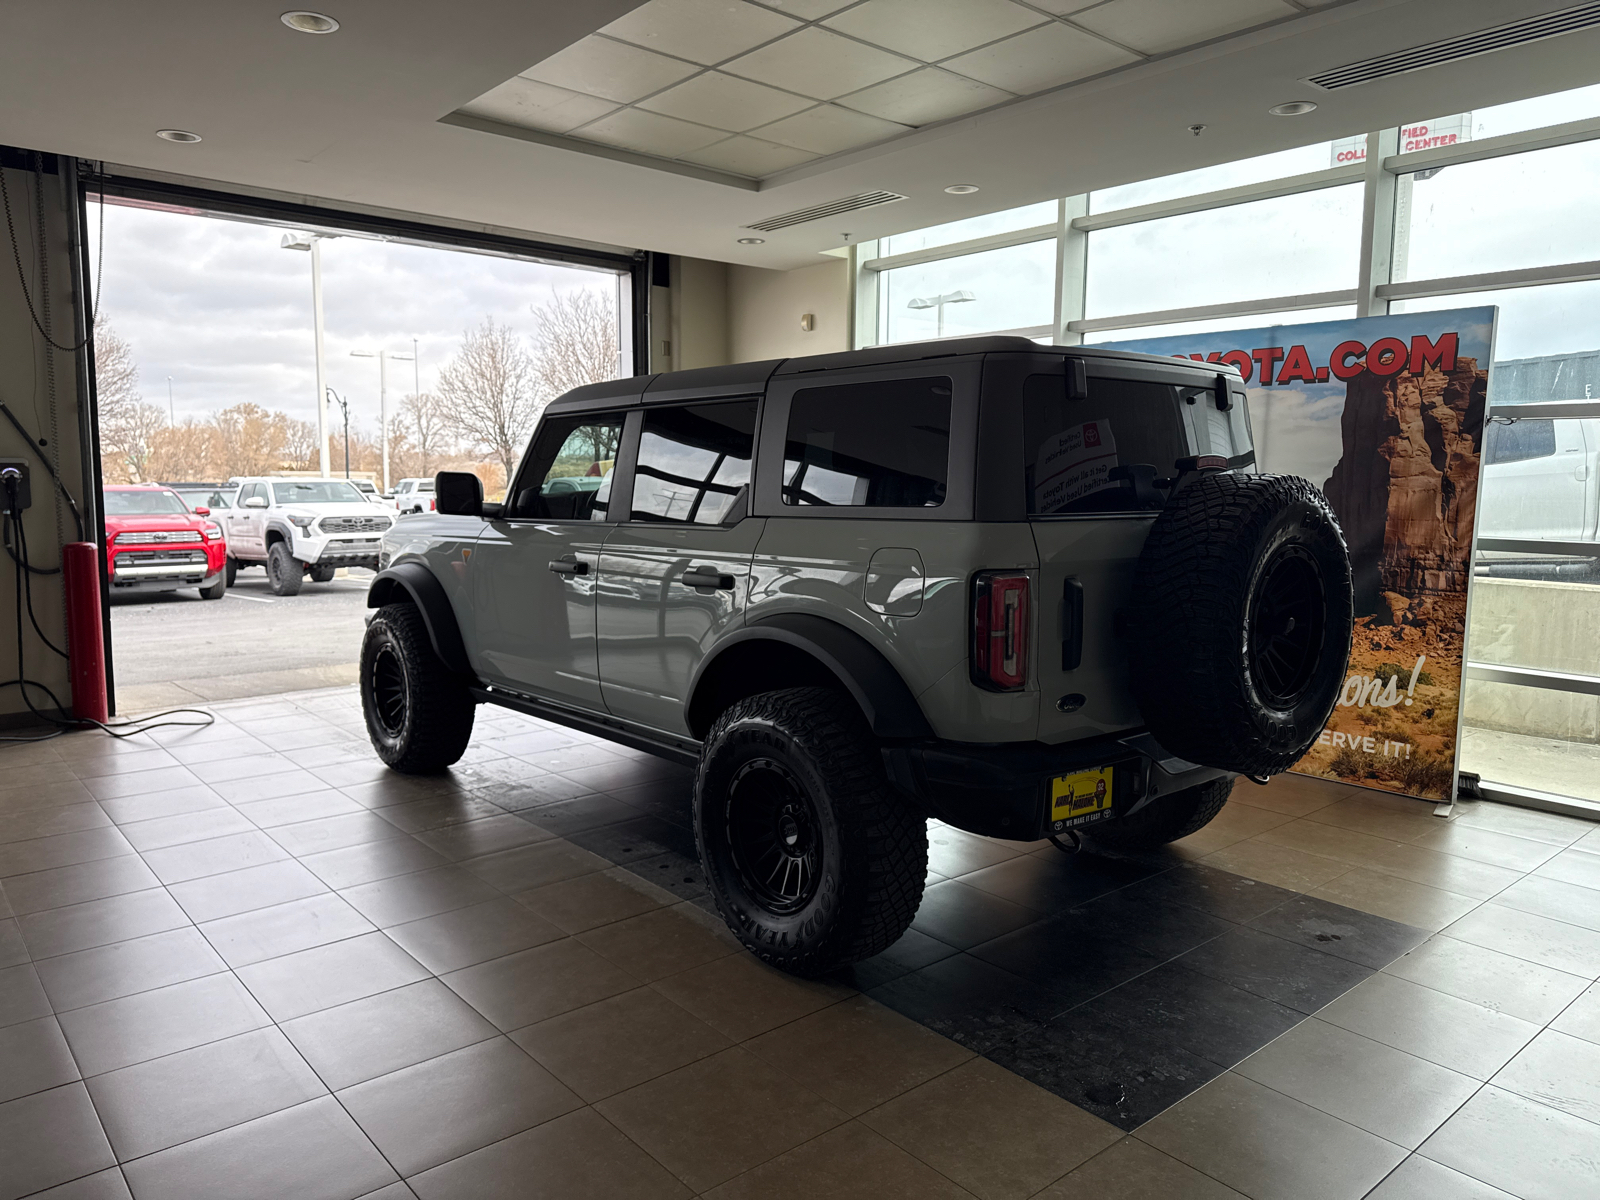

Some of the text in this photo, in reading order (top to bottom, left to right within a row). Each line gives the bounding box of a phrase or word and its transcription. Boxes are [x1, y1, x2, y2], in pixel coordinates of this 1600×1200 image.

[1405, 133, 1458, 151] CENTER
[1383, 740, 1411, 760] IT!
[1097, 782, 1105, 791] 32
[1066, 812, 1101, 827] WE MAKE IT EASY
